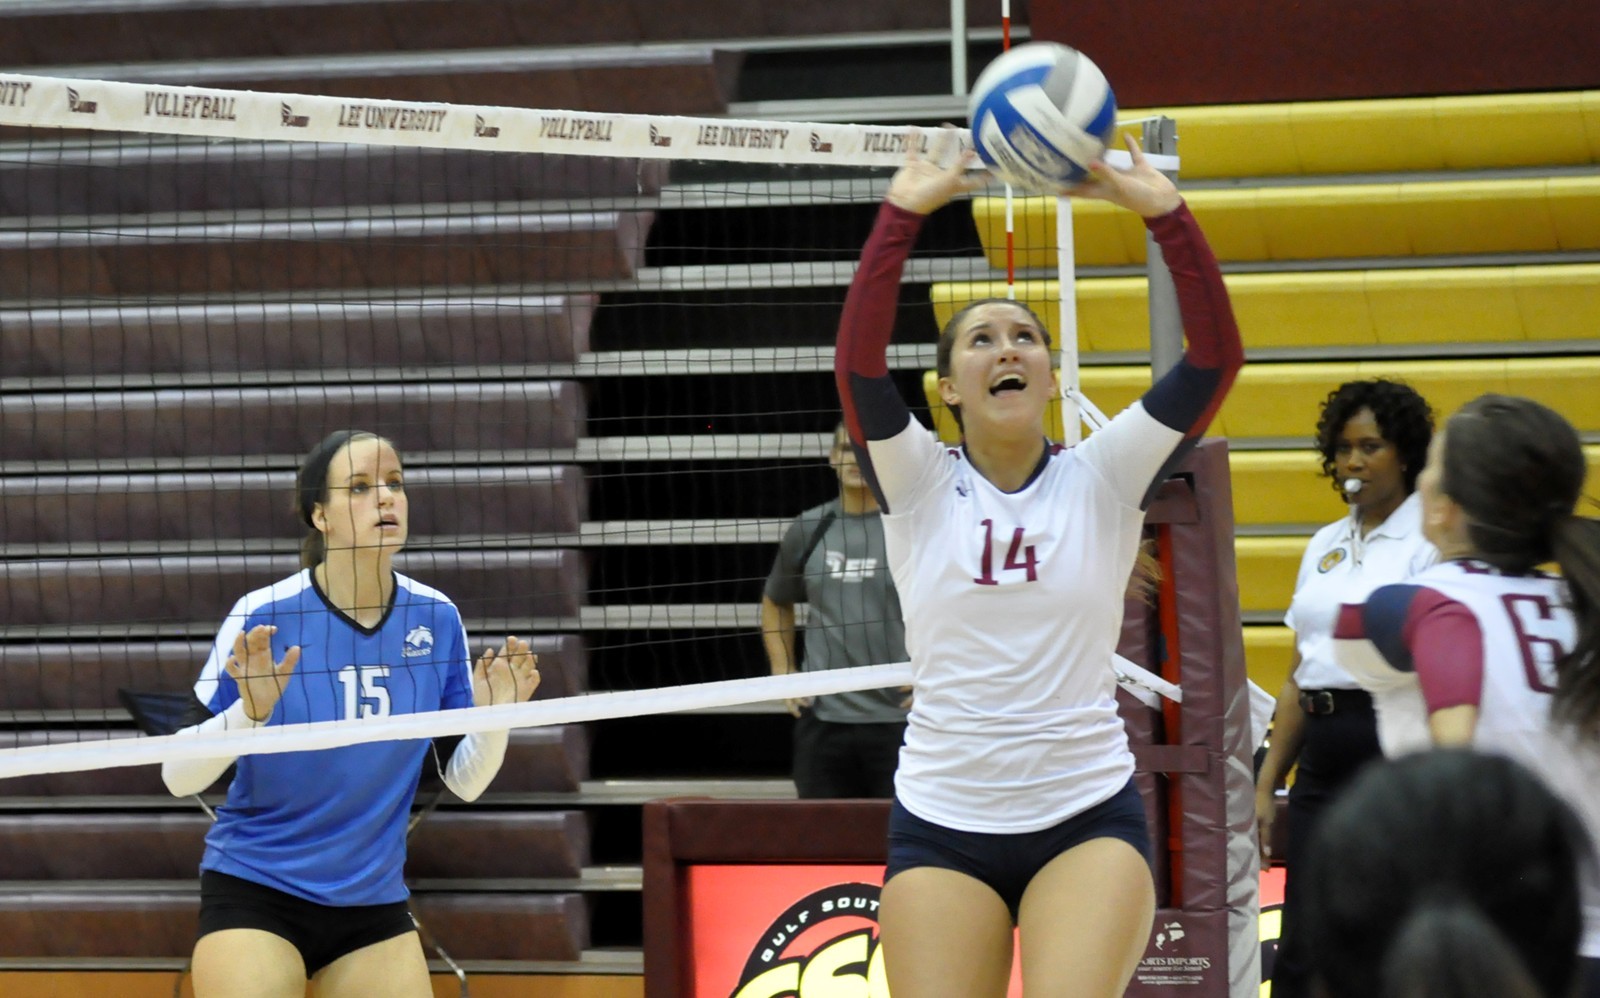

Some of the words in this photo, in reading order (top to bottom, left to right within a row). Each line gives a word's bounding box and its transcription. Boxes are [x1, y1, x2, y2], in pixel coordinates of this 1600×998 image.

[144, 91, 236, 121] VOLLEYBALL
[338, 104, 362, 127] LEE
[697, 125, 719, 146] LEE
[973, 518, 1040, 585] 14
[1499, 592, 1564, 694] 6
[338, 664, 391, 720] 15
[761, 910, 809, 963] GULF
[821, 896, 880, 912] SOUT
